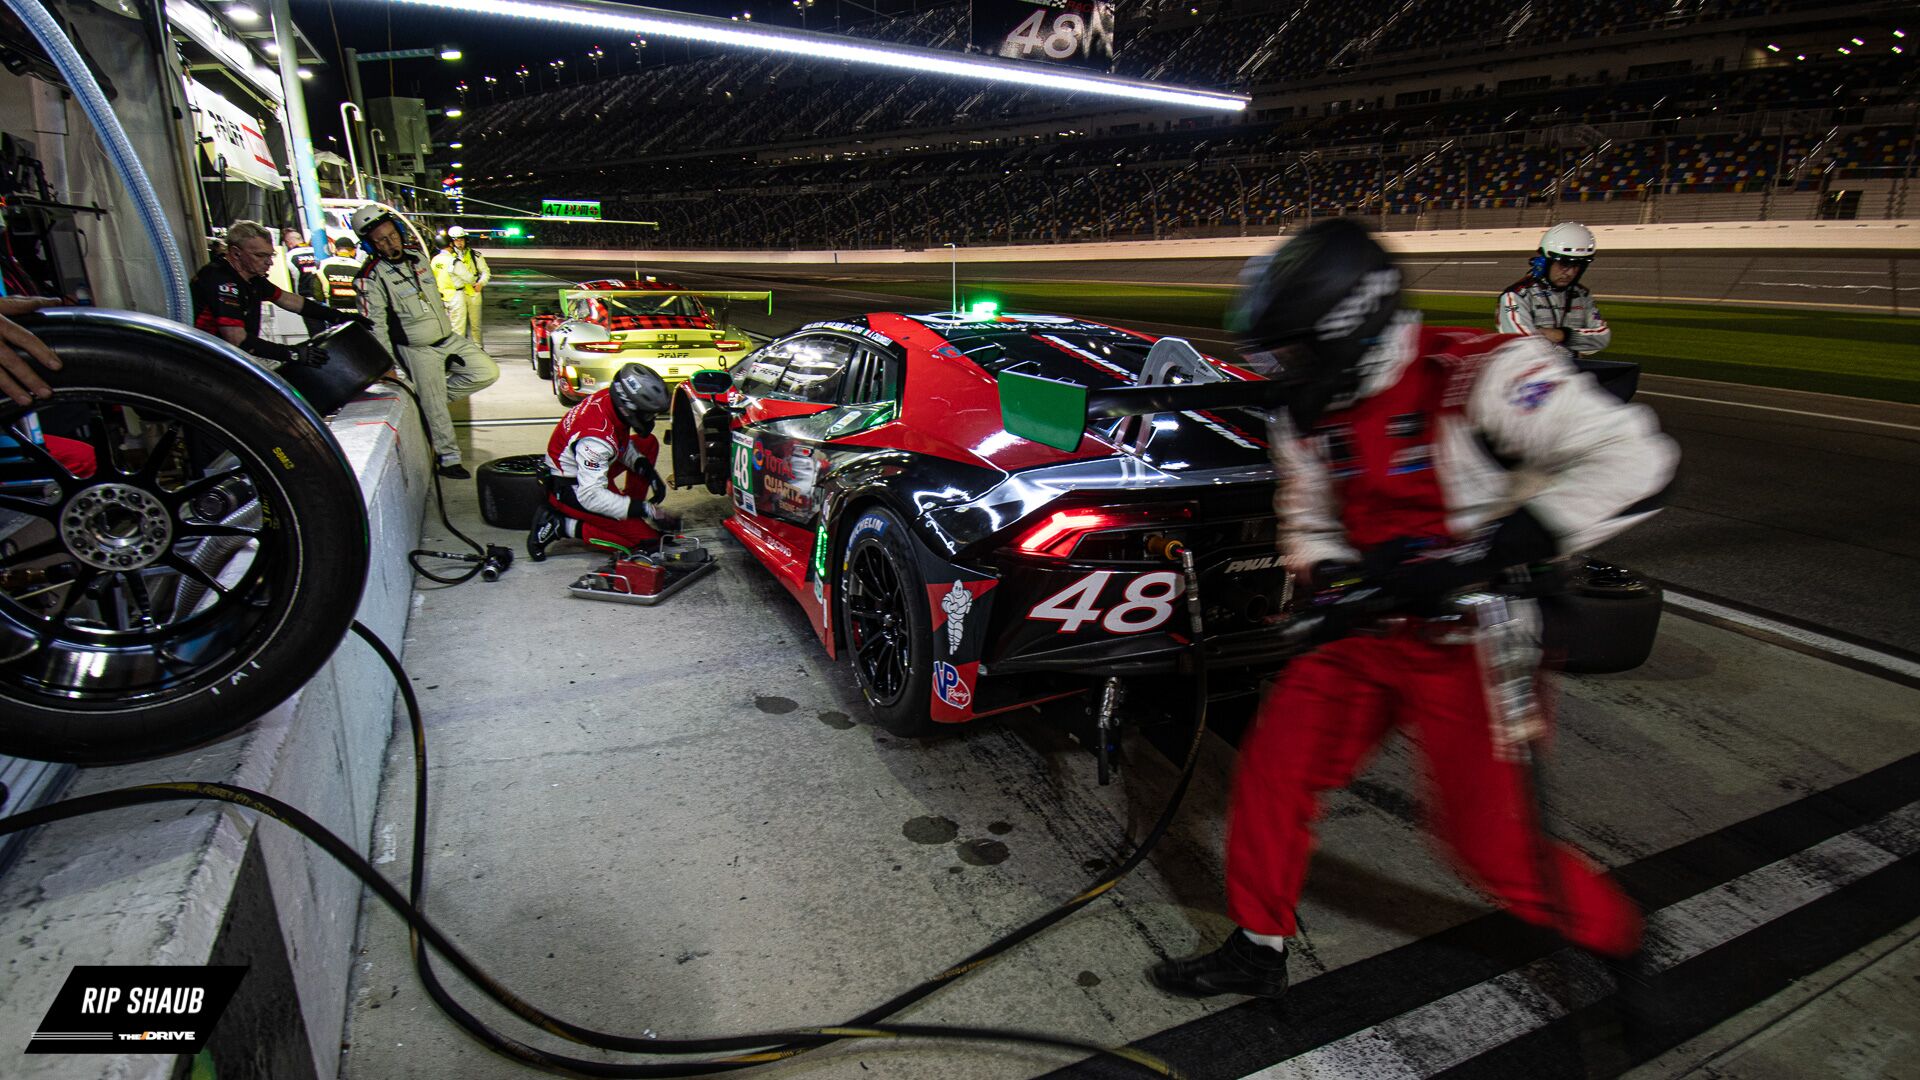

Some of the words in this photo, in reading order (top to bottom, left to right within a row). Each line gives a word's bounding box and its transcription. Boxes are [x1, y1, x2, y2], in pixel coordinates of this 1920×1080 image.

[1005, 9, 1085, 59] 48
[545, 204, 562, 216] 47
[718, 355, 728, 371] 9
[733, 445, 750, 490] 48
[764, 449, 797, 480] TOTAL
[764, 474, 804, 505] QUARTZ
[1224, 556, 1275, 574] PAUL
[1025, 571, 1187, 634] 48
[933, 660, 959, 701] VP
